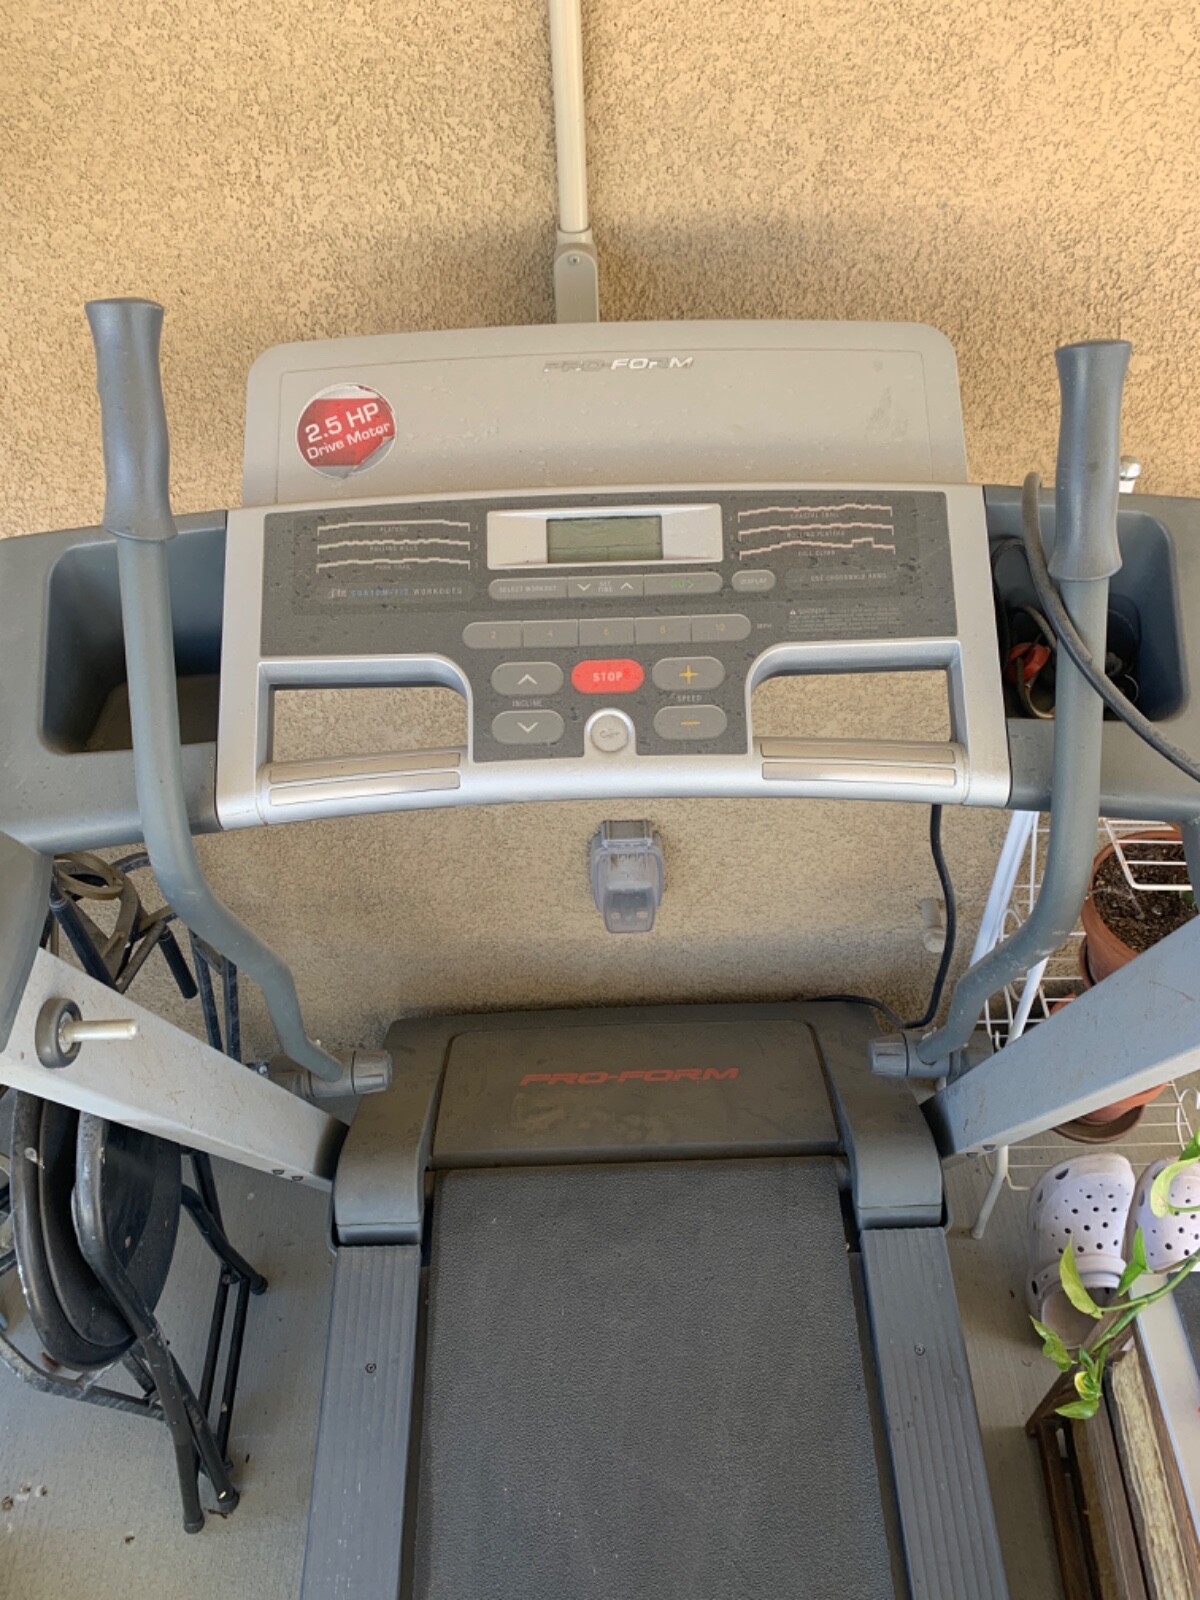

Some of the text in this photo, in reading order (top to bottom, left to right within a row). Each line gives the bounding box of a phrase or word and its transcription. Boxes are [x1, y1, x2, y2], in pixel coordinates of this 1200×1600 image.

[305, 402, 379, 443] 2.5 HP
[307, 422, 390, 460] Drive Motor
[739, 577, 768, 586] DISPLAY
[413, 587, 463, 596] WORKOUTS
[525, 584, 557, 592] WORKOUT
[490, 631, 497, 639] 2
[547, 629, 554, 637] 4
[659, 625, 667, 634] 8
[714, 623, 726, 633] 10
[592, 672, 624, 682] STOP
[677, 694, 702, 703] SPEED
[519, 1067, 739, 1086] PRO-FORM
